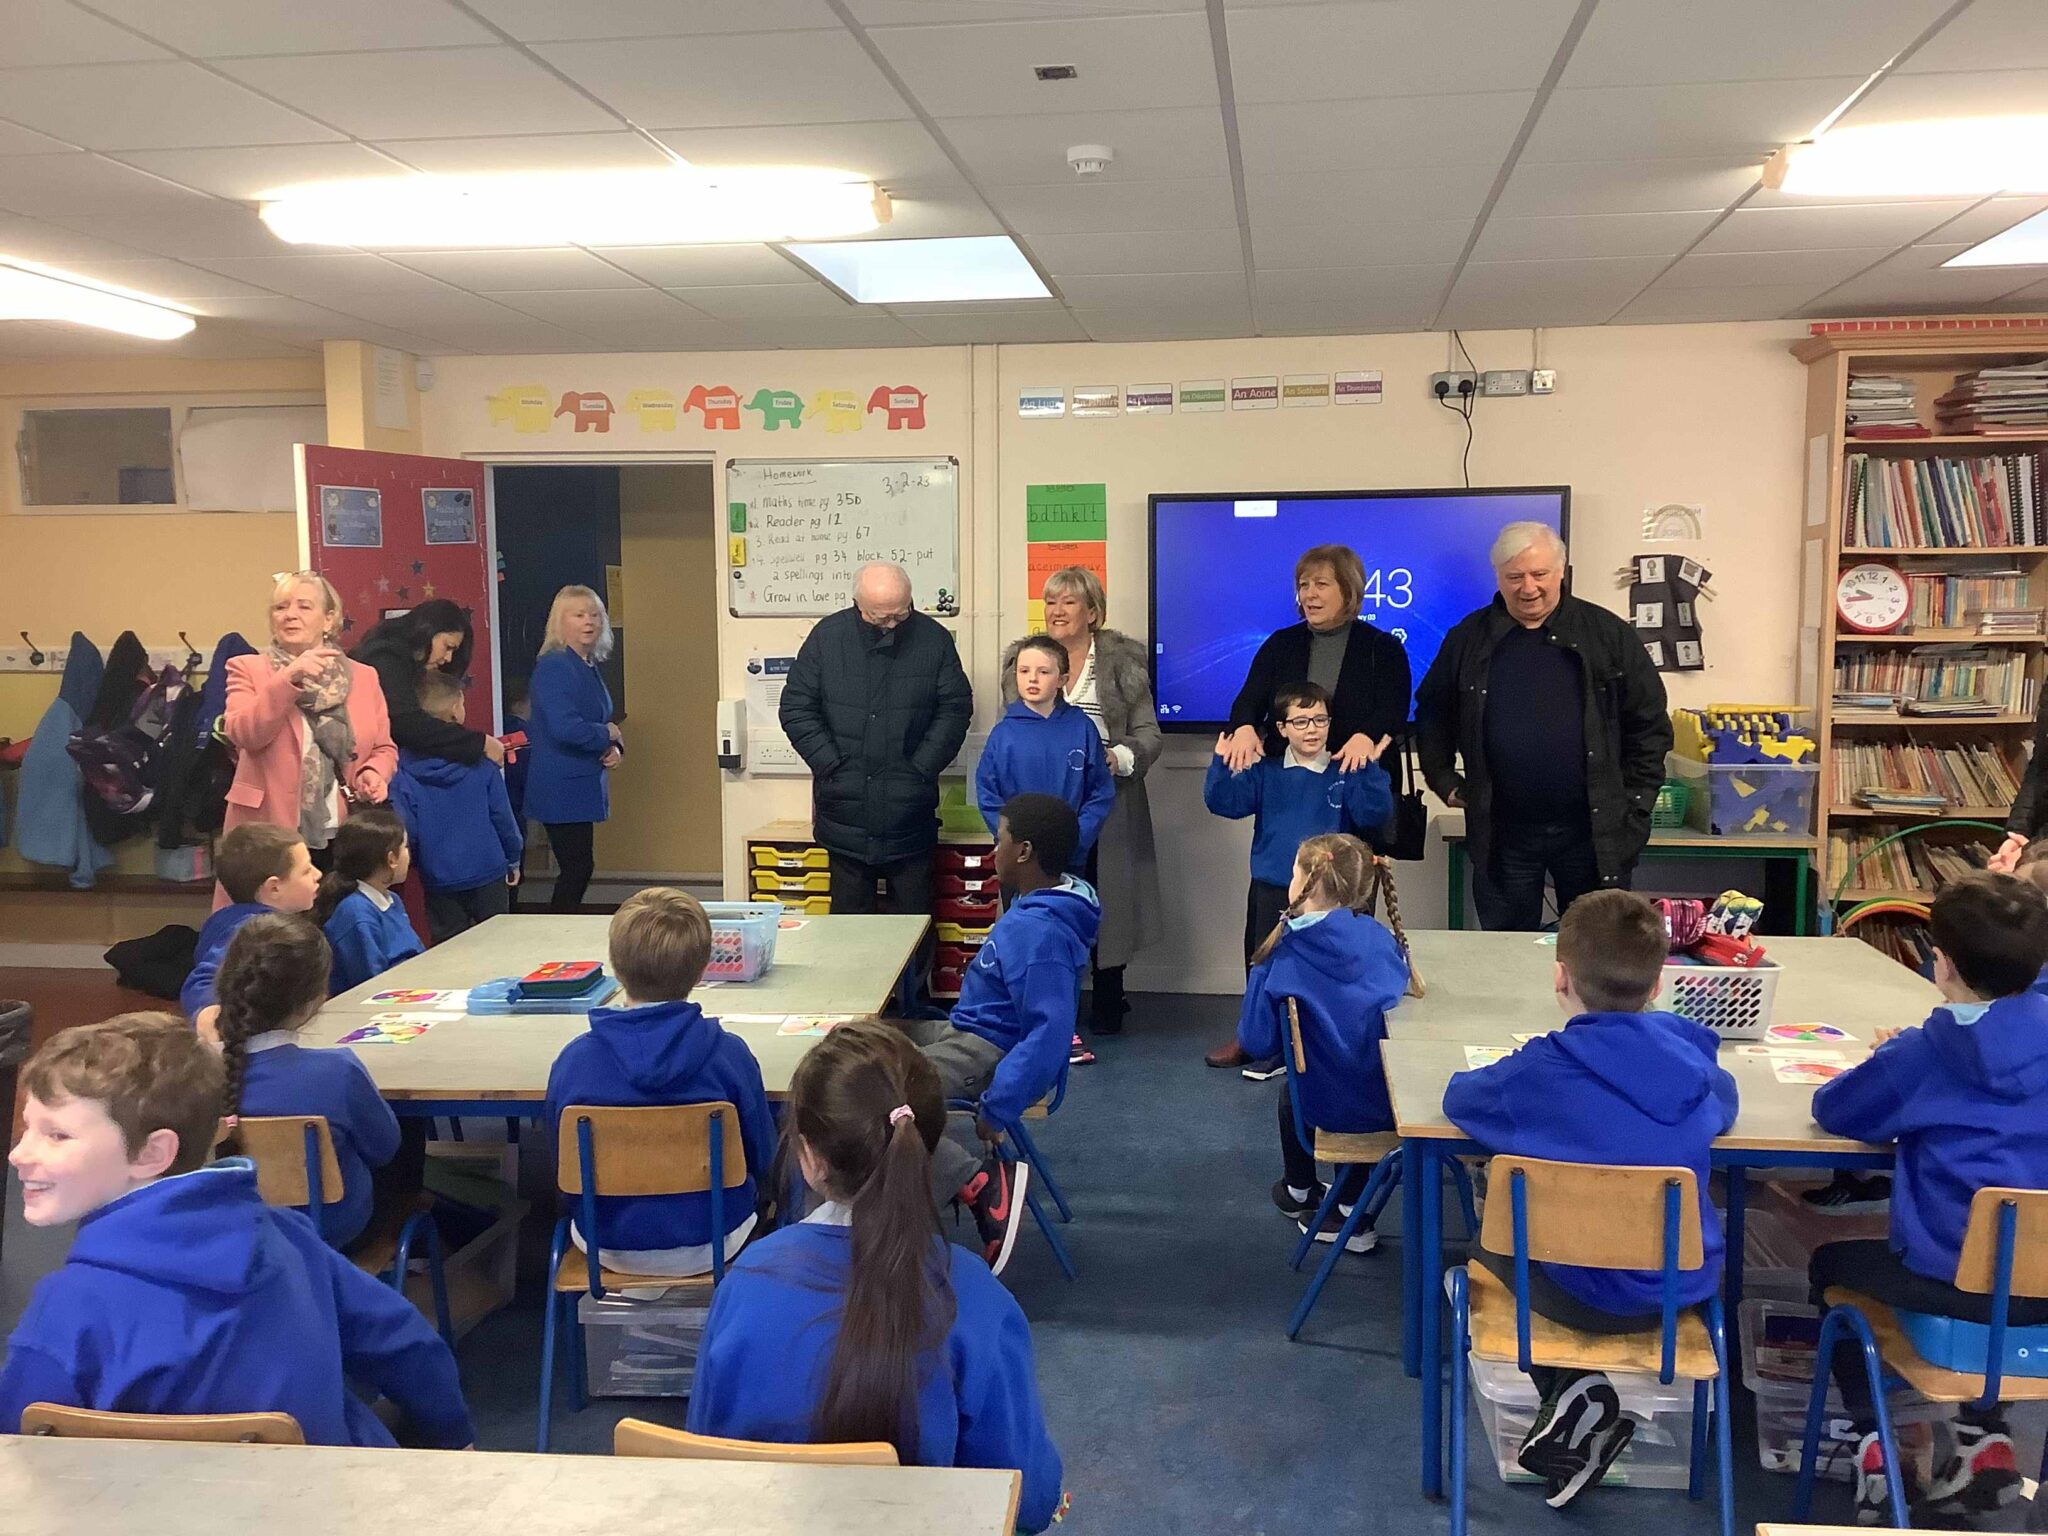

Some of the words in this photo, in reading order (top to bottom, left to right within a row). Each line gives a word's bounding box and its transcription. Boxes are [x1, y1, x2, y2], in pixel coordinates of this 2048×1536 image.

[1234, 389, 1247, 399] An
[1249, 388, 1277, 398] Aoine
[707, 398, 733, 407] Thursday
[775, 399, 793, 408] Friday
[831, 400, 857, 411] Saturday
[894, 398, 915, 406] Sunday
[763, 468, 813, 481] Homework
[766, 514, 805, 529] Reader
[810, 517, 821, 530] pg
[828, 513, 843, 526] 12
[855, 526, 871, 540] 67
[815, 551, 829, 565] pg
[857, 549, 883, 562] block
[916, 549, 935, 565] put
[784, 569, 824, 585] spellings
[832, 570, 851, 581] into
[1854, 573, 1866, 583] 11
[1867, 572, 1879, 581] 12
[1882, 576, 1888, 584] 1
[1846, 579, 1856, 589] 10
[1889, 585, 1898, 593] 2
[763, 584, 791, 604] Grow
[796, 592, 807, 603] in
[812, 590, 830, 603] love
[834, 593, 847, 608] pg
[1854, 611, 1862, 619] 7
[1866, 616, 1873, 624] 6
[1878, 614, 1886, 622] 5
